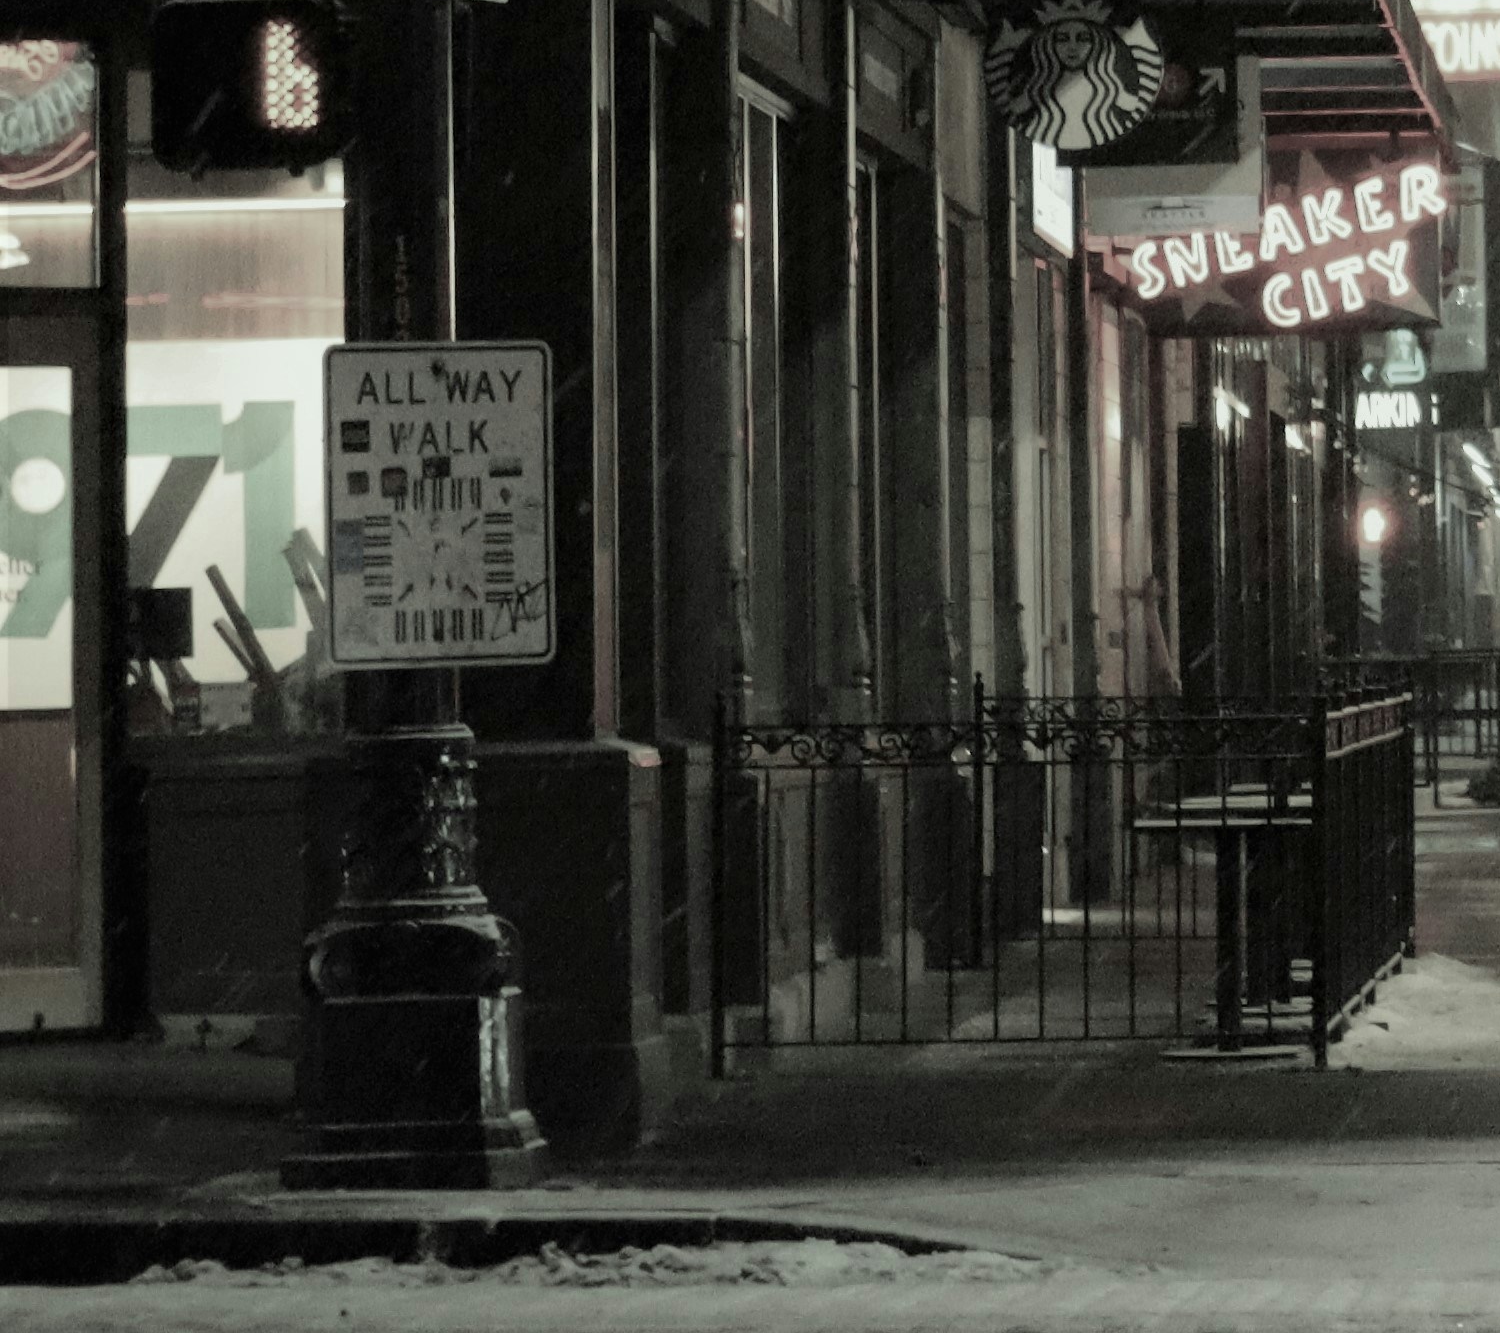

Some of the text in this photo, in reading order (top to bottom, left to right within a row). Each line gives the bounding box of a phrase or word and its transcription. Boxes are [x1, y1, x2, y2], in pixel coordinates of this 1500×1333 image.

[1130, 163, 1448, 300] SNEAKER
[1261, 238, 1410, 329] CITY
[356, 368, 522, 406] ALL WAY
[389, 418, 489, 456] WALK
